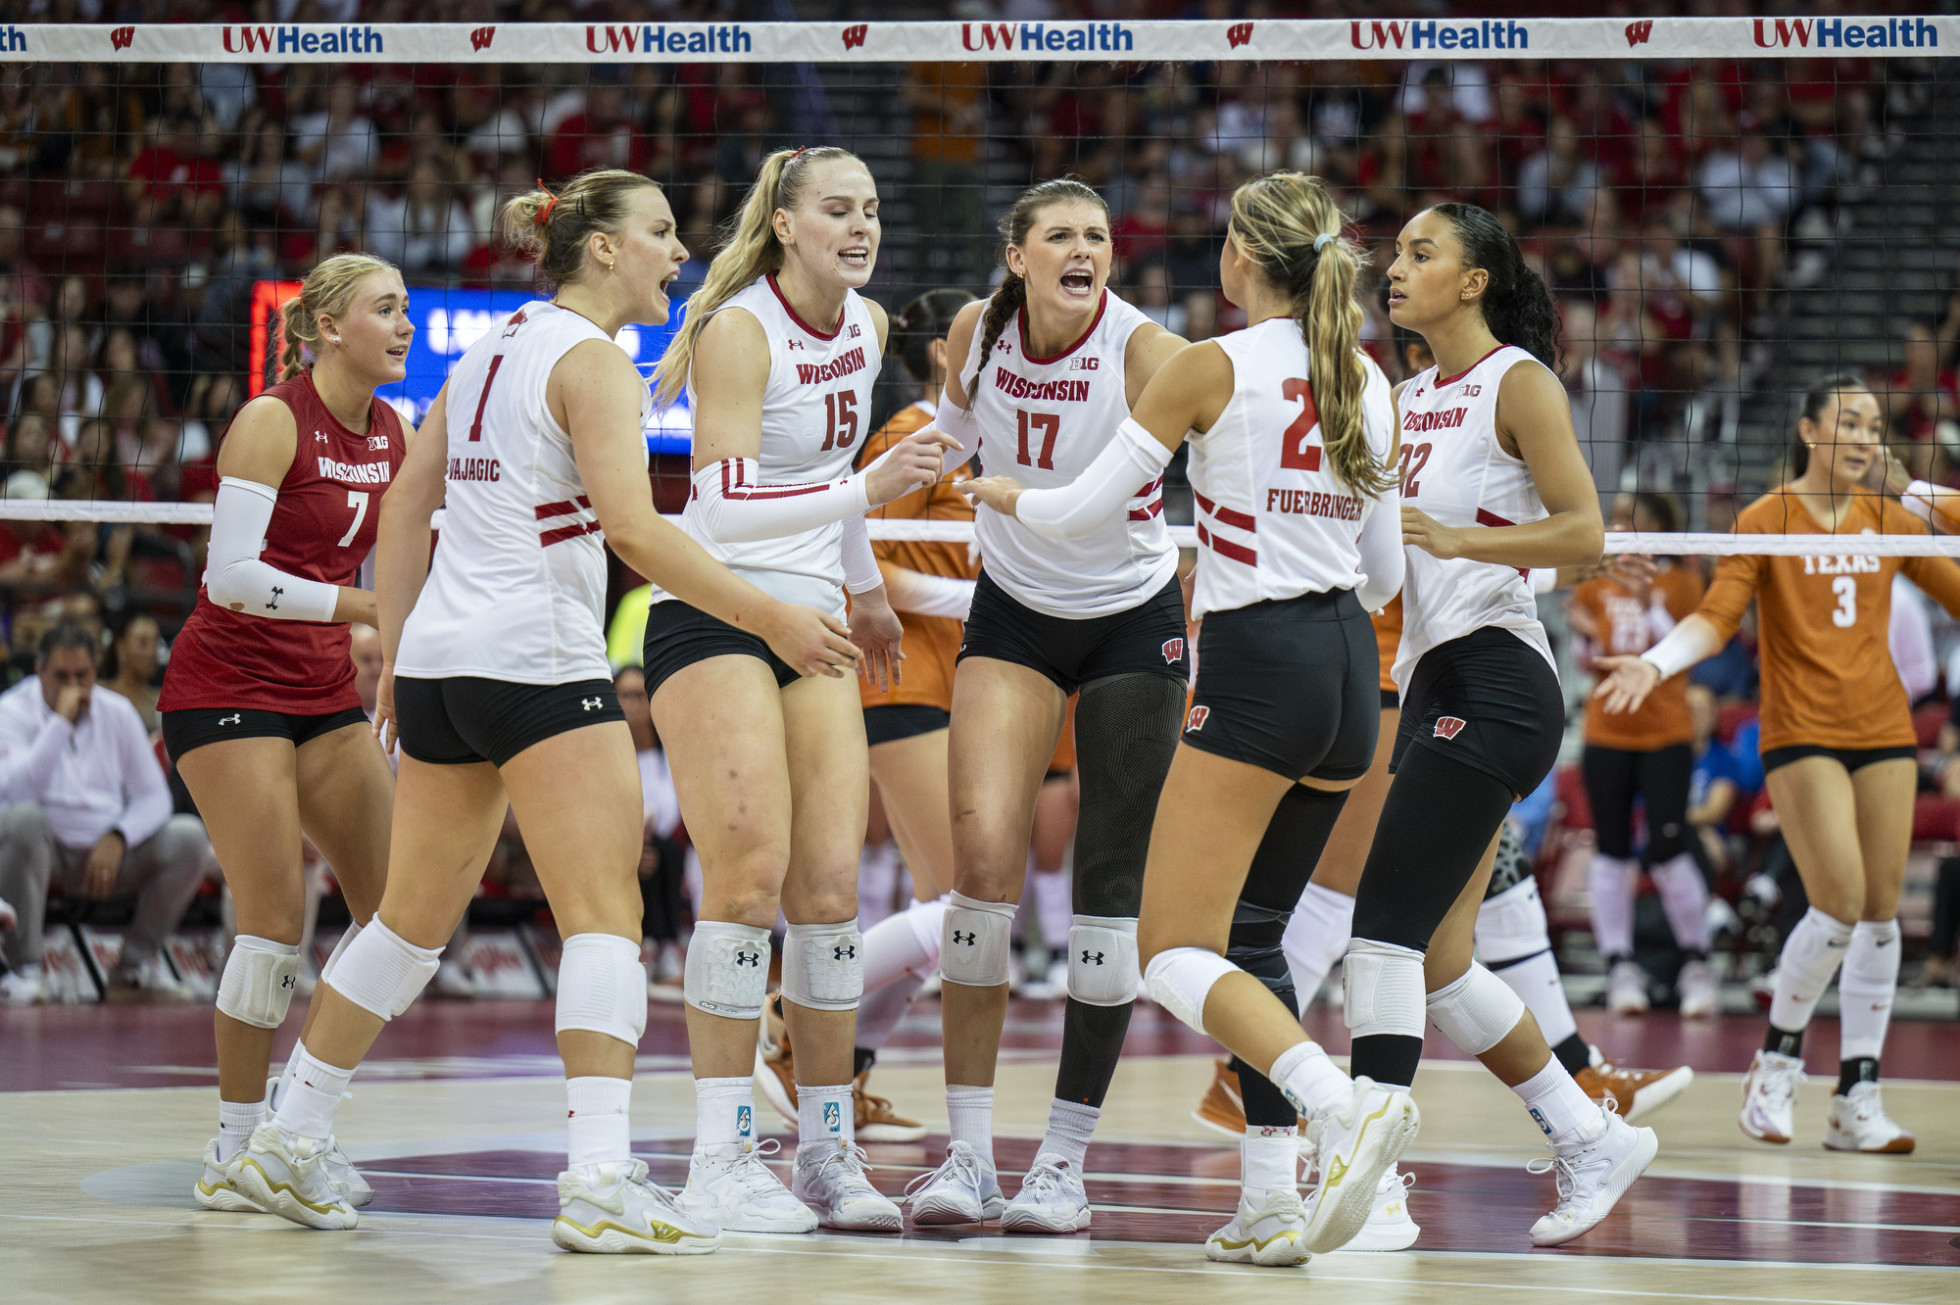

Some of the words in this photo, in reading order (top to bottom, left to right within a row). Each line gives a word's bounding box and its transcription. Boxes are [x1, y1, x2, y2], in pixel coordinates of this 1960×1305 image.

[468, 354, 504, 442] 1
[995, 366, 1090, 402] WISCONSIN
[820, 389, 858, 452] 15
[1016, 408, 1060, 470] 17
[1280, 377, 1322, 472] 2
[318, 456, 390, 484] WISCONSIN
[449, 457, 501, 482] VAJAGIC
[337, 490, 370, 548] 7
[1266, 488, 1364, 521] FUERBRINGER
[1802, 555, 1881, 575] TEXAS
[1831, 575, 1857, 628] 3
